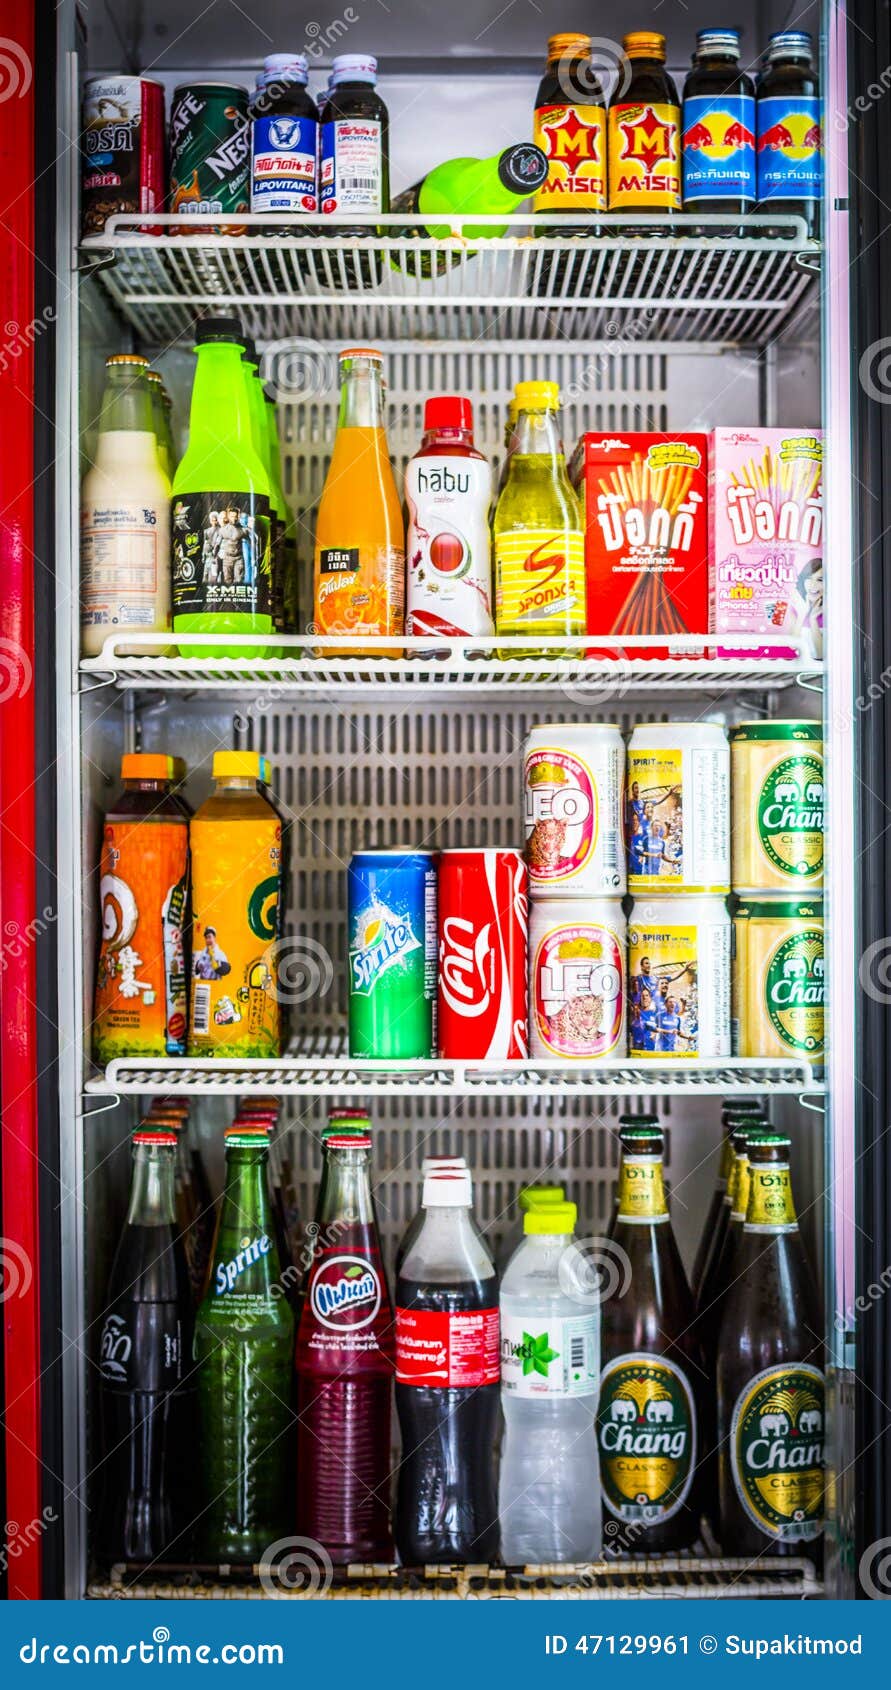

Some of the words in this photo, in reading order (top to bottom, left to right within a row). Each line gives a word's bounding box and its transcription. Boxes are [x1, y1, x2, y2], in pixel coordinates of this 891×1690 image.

[555, 129, 589, 156] M
[633, 128, 667, 156] M
[255, 180, 314, 194] LIPOVITAN-D
[618, 176, 679, 192] M-150
[687, 169, 751, 181] กระทิงแดง
[633, 758, 656, 766] SPIRIT
[763, 803, 825, 832] Chan
[353, 923, 408, 989] Sprite
[540, 963, 622, 1002] LEO
[771, 980, 826, 1004] Chan
[216, 1235, 269, 1295] Sprite
[600, 1422, 687, 1459] Chang
[617, 1461, 669, 1472] CLASSIC
